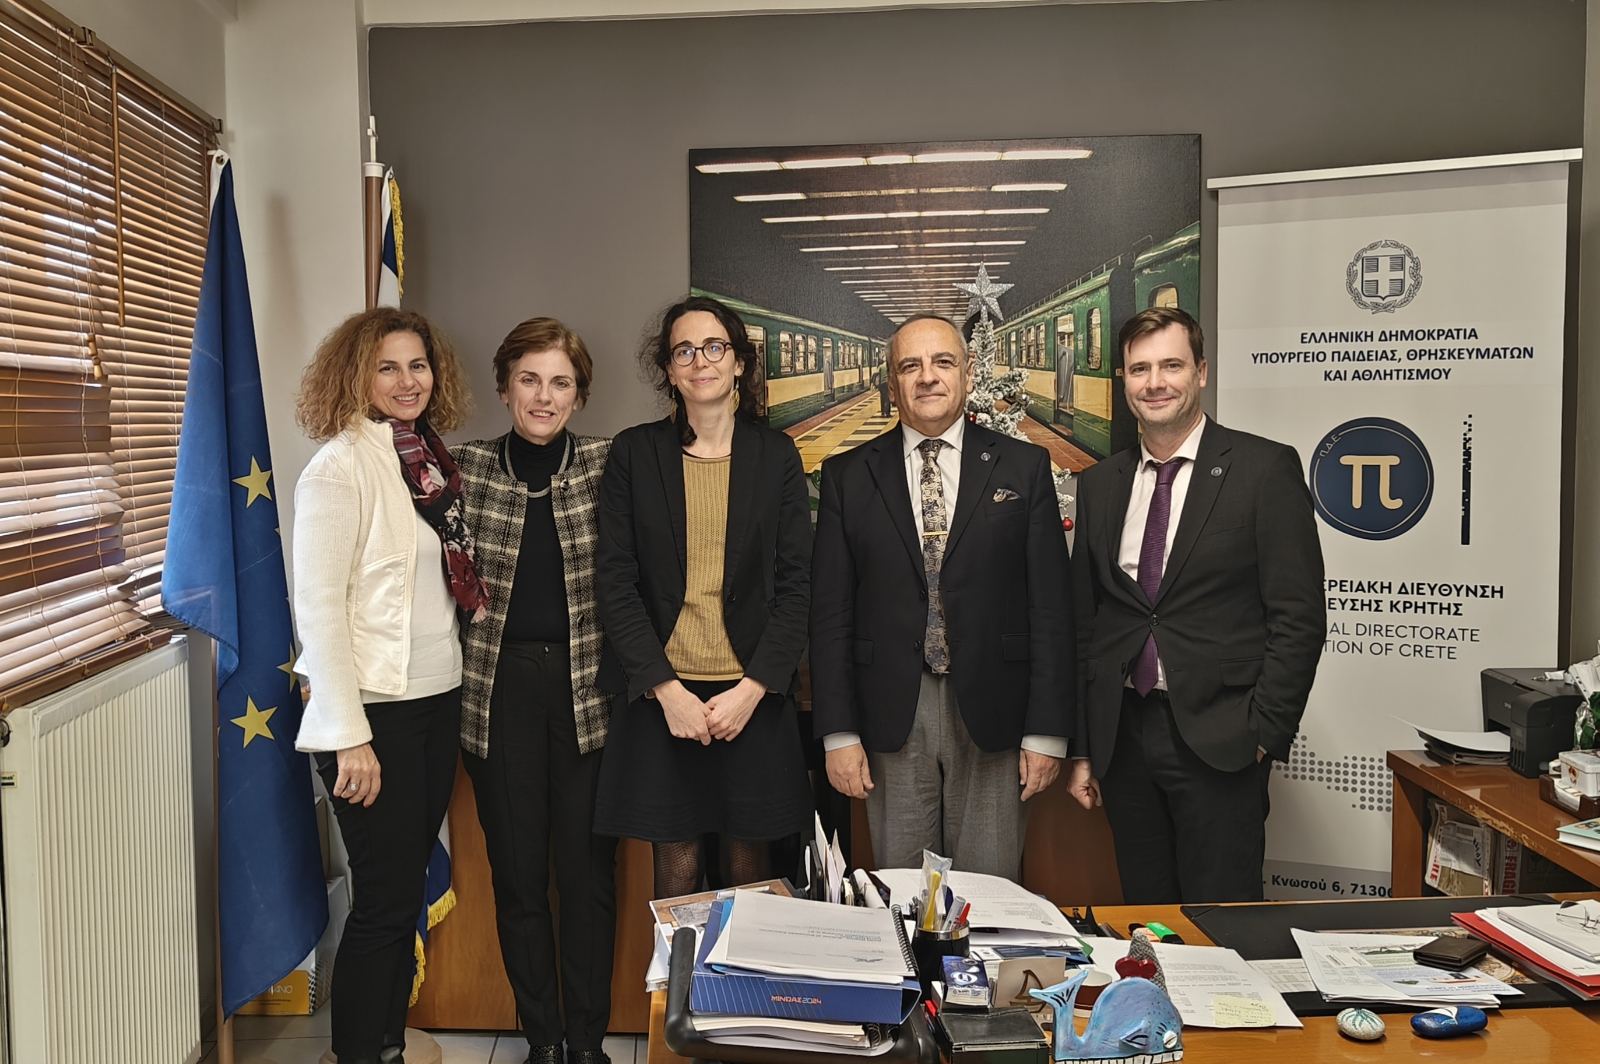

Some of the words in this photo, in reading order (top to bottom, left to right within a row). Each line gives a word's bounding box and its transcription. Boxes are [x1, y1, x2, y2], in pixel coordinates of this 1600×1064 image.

[1300, 331, 1374, 344] ΕΛΛΗΝΙΚΗ
[1378, 328, 1479, 342] ΔΗΜΟΚΡΑΤΙΑ
[1251, 350, 1327, 364] ΥΠΟΥΡΓΕΙΟ
[1331, 349, 1402, 363] ΠΑΙΔΕΙΑΣ,
[1406, 346, 1534, 361] ΘΡΗΣΚΕΥΜΑΤΩΝ
[1324, 369, 1347, 381] ΚΑΙ
[1351, 368, 1452, 381] ΑΘΛΗΤΙΣΜΟΥ
[1323, 579, 1392, 594] ΡΕΙΑΚΗ
[1397, 581, 1504, 599] ΔΙΕΥΘΥΝΣΗ
[1327, 597, 1384, 612] ΕΥΣΗΣ
[1389, 600, 1464, 616] ΚΡΗΤΗΣ
[1329, 621, 1350, 636] AL
[1355, 623, 1480, 642] DIRECTORATE
[1323, 639, 1363, 654] TION
[1369, 642, 1394, 656] OF
[1399, 643, 1457, 660] CRETE
[1271, 874, 1327, 891] Κνωσού
[1331, 881, 1345, 895] 6,
